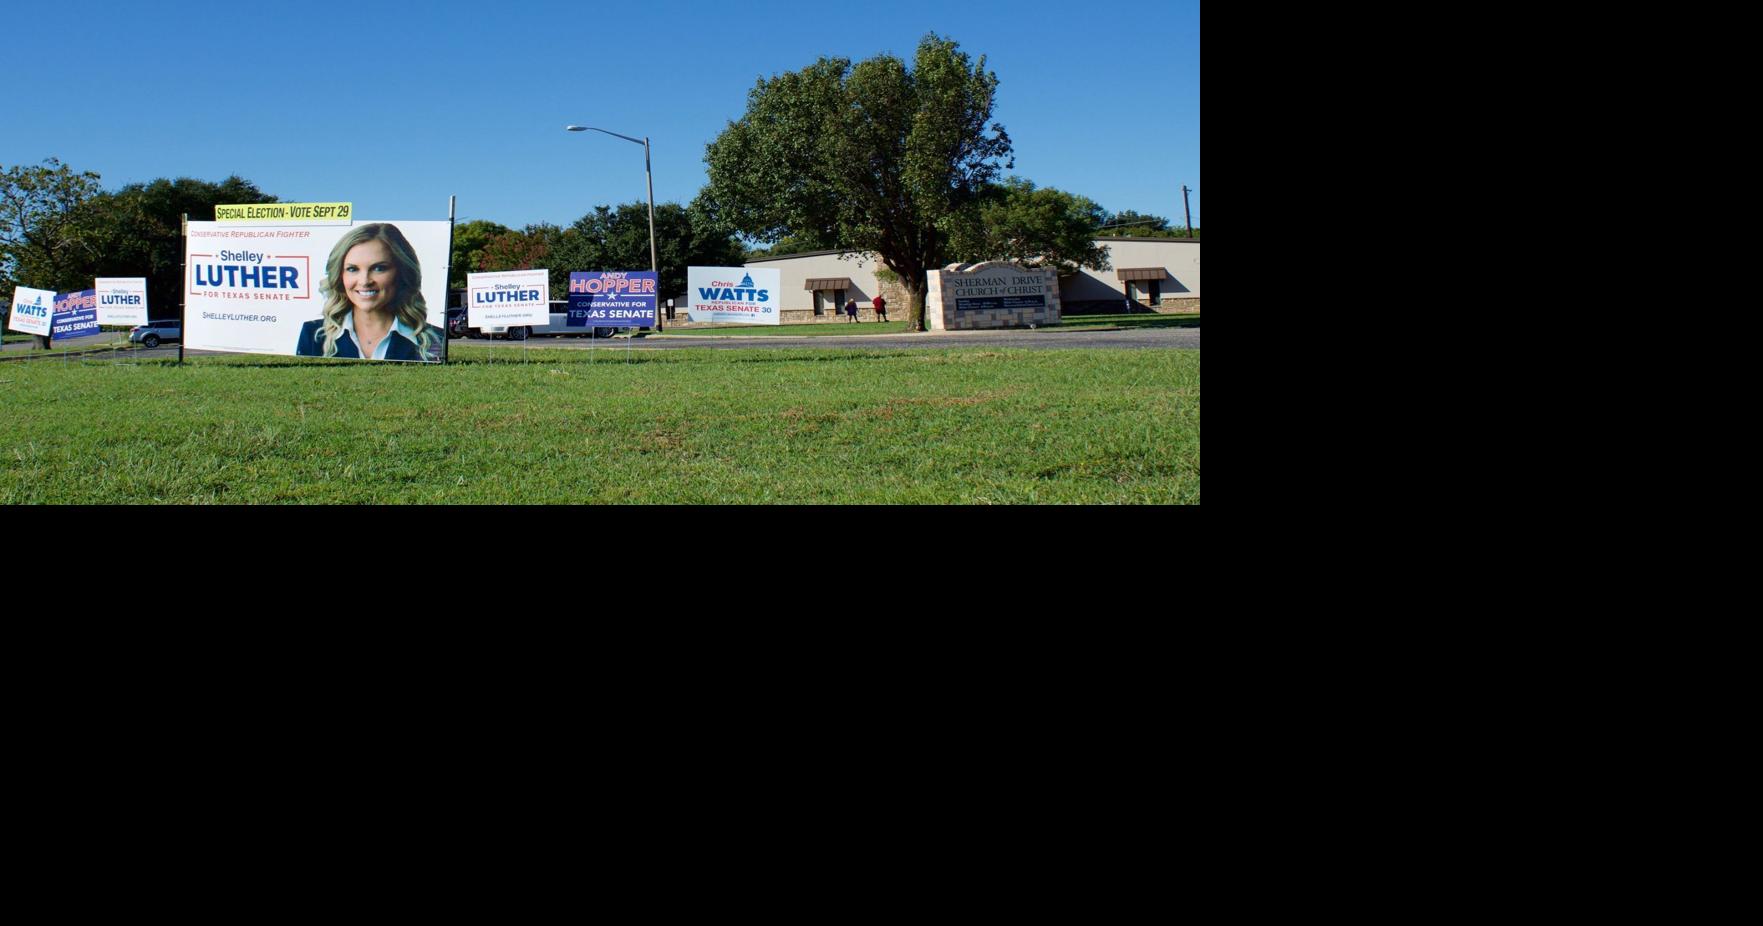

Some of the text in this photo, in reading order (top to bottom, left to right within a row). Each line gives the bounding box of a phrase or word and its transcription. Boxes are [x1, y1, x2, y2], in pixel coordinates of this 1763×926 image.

[217, 207, 245, 219] SPECIAL
[247, 206, 285, 219] ELECTION
[290, 205, 311, 218] VOTE
[313, 205, 336, 218] SEPT
[337, 205, 349, 218] 29
[230, 230, 275, 238] REPUBLICAN
[276, 230, 310, 238] FIGHTER
[220, 249, 263, 264] Shelley
[196, 264, 299, 289] LUTHER
[600, 272, 628, 280] ANDY
[954, 275, 1042, 288] SHERMAN DRIVE
[494, 283, 520, 291] Shelley
[569, 278, 656, 293] HOPPER
[711, 280, 733, 288] Chris
[222, 292, 250, 300] TEXAS
[253, 293, 290, 301] SENATE
[476, 289, 540, 303] LUTHER
[698, 287, 769, 303] WATTS
[955, 287, 998, 297] CHURCH
[1007, 285, 1043, 295] CHRIST
[101, 294, 141, 305] LUTHER
[16, 303, 47, 318] WATTS
[568, 309, 654, 318] TEXAS SENATE
[695, 304, 724, 312] TEXAS
[726, 304, 760, 313] SENATE
[53, 324, 73, 333] TEXAS
[73, 320, 99, 330] SENATE
